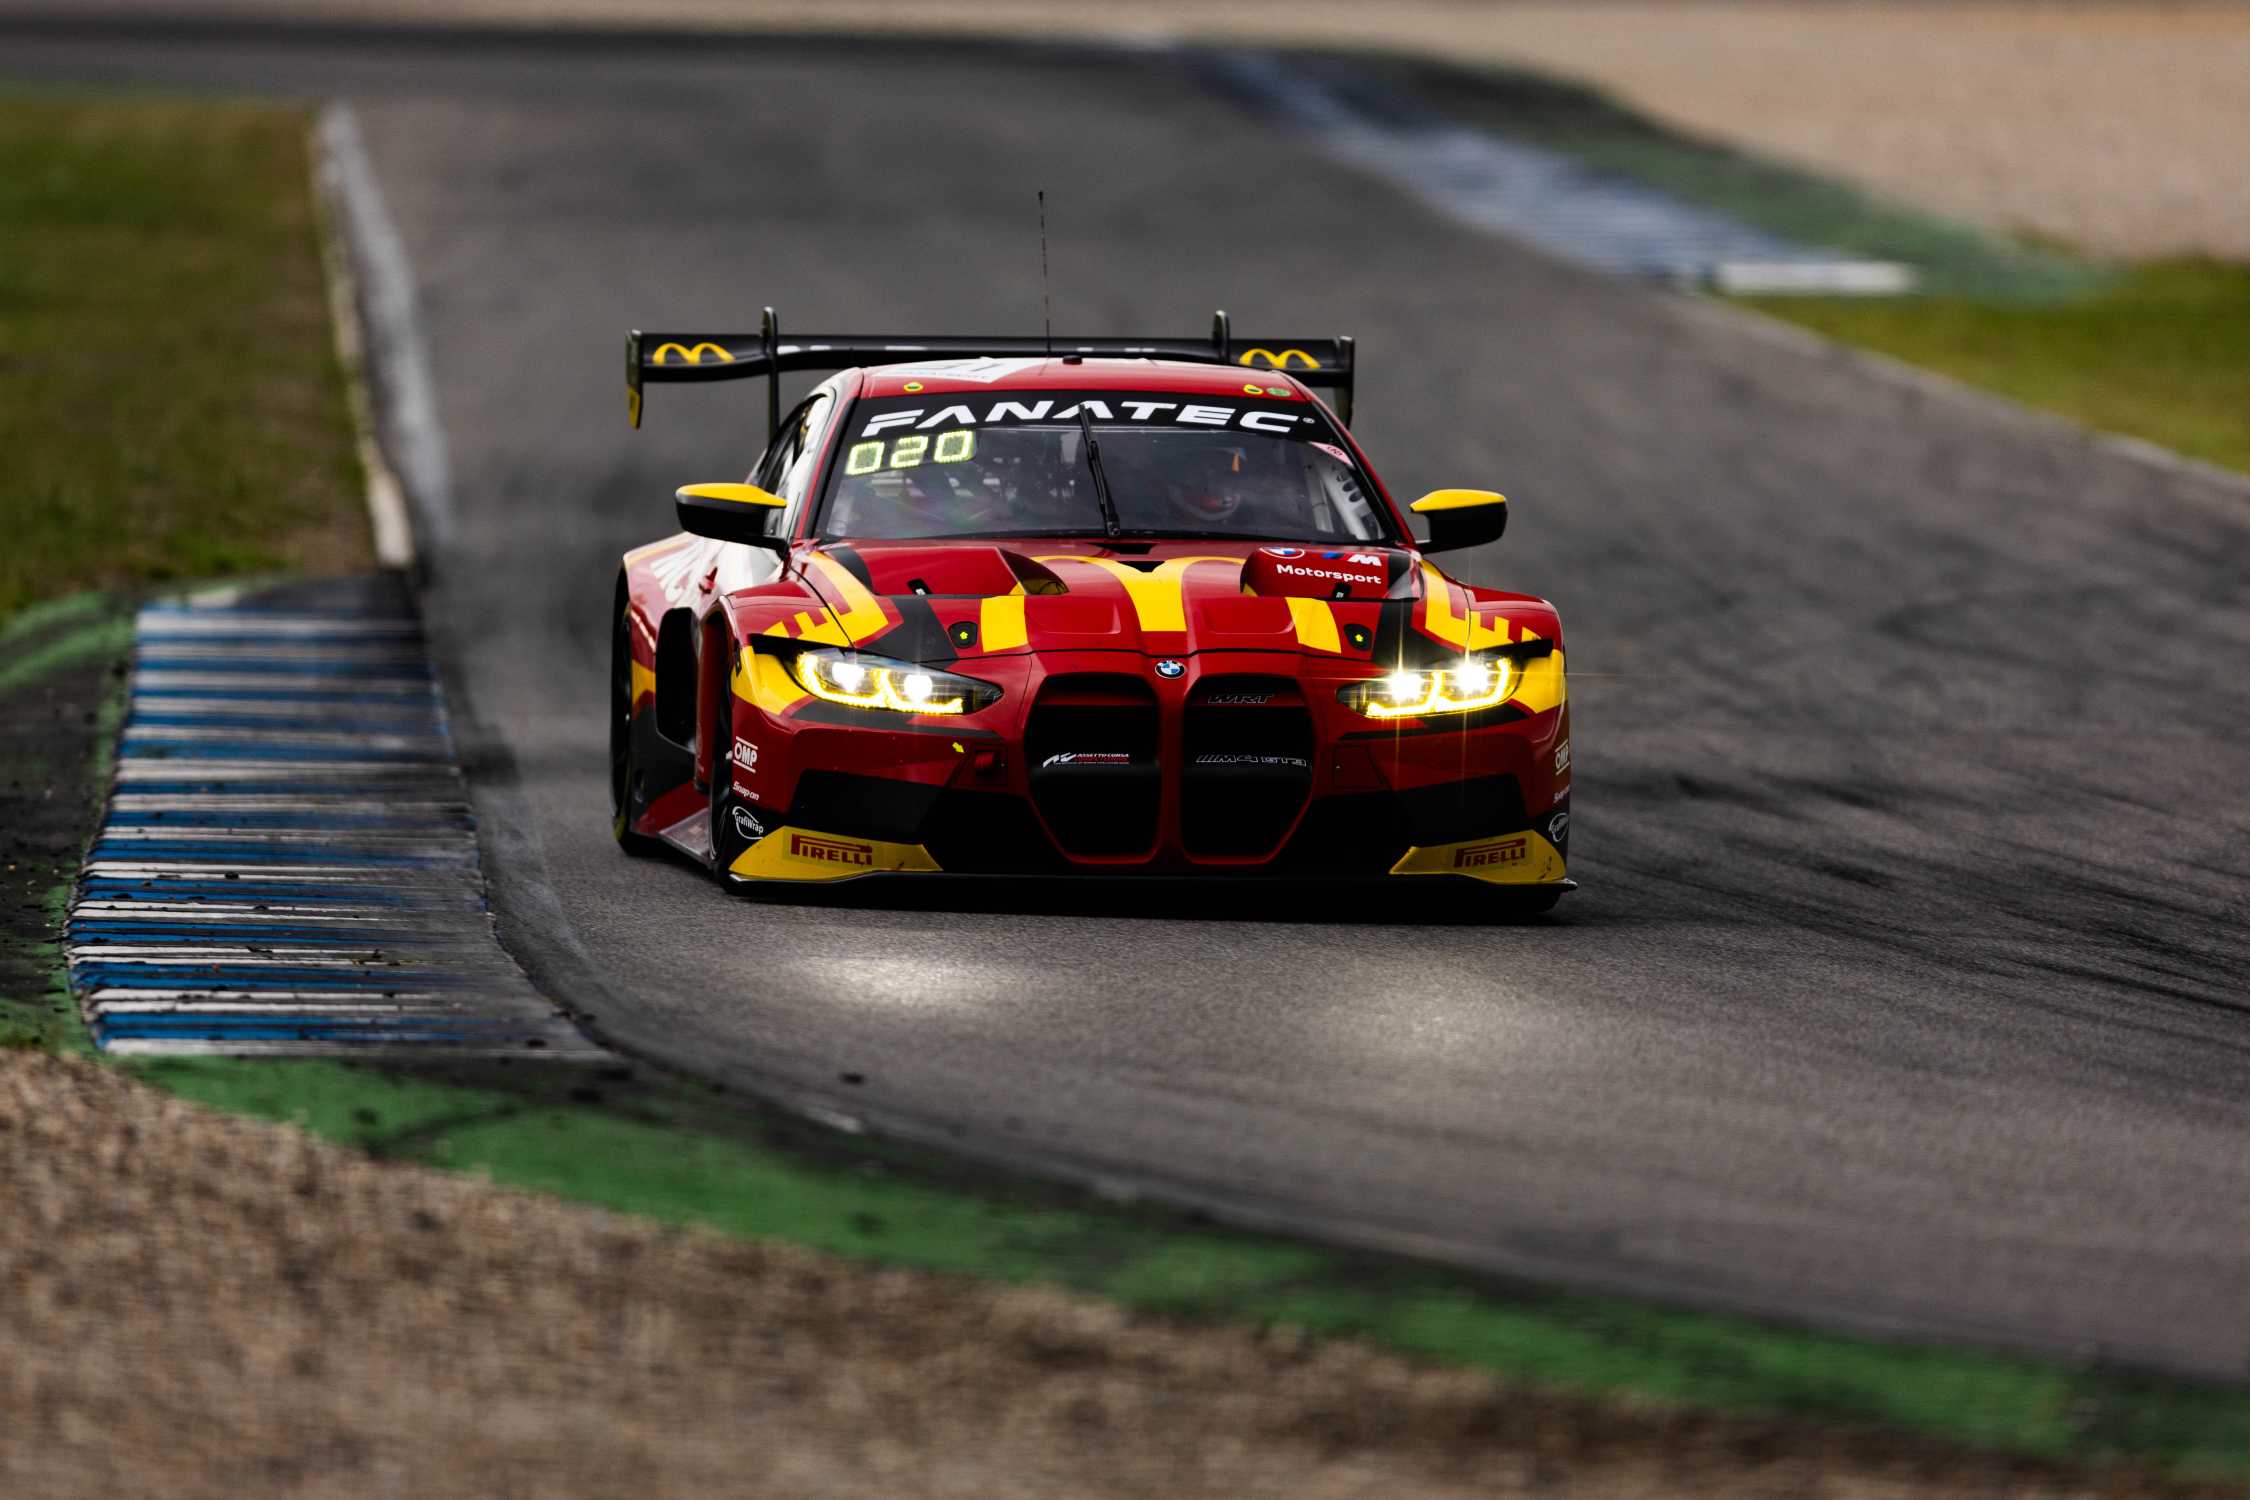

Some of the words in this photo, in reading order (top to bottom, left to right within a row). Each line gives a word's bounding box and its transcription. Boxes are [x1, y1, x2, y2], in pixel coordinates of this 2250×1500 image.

[861, 400, 1299, 438] FANATEC
[845, 430, 974, 475] 020
[1276, 563, 1382, 585] Motorsport
[734, 742, 758, 767] OMP
[790, 833, 873, 866] PIRELLI
[1454, 838, 1527, 868] PIRELLI
